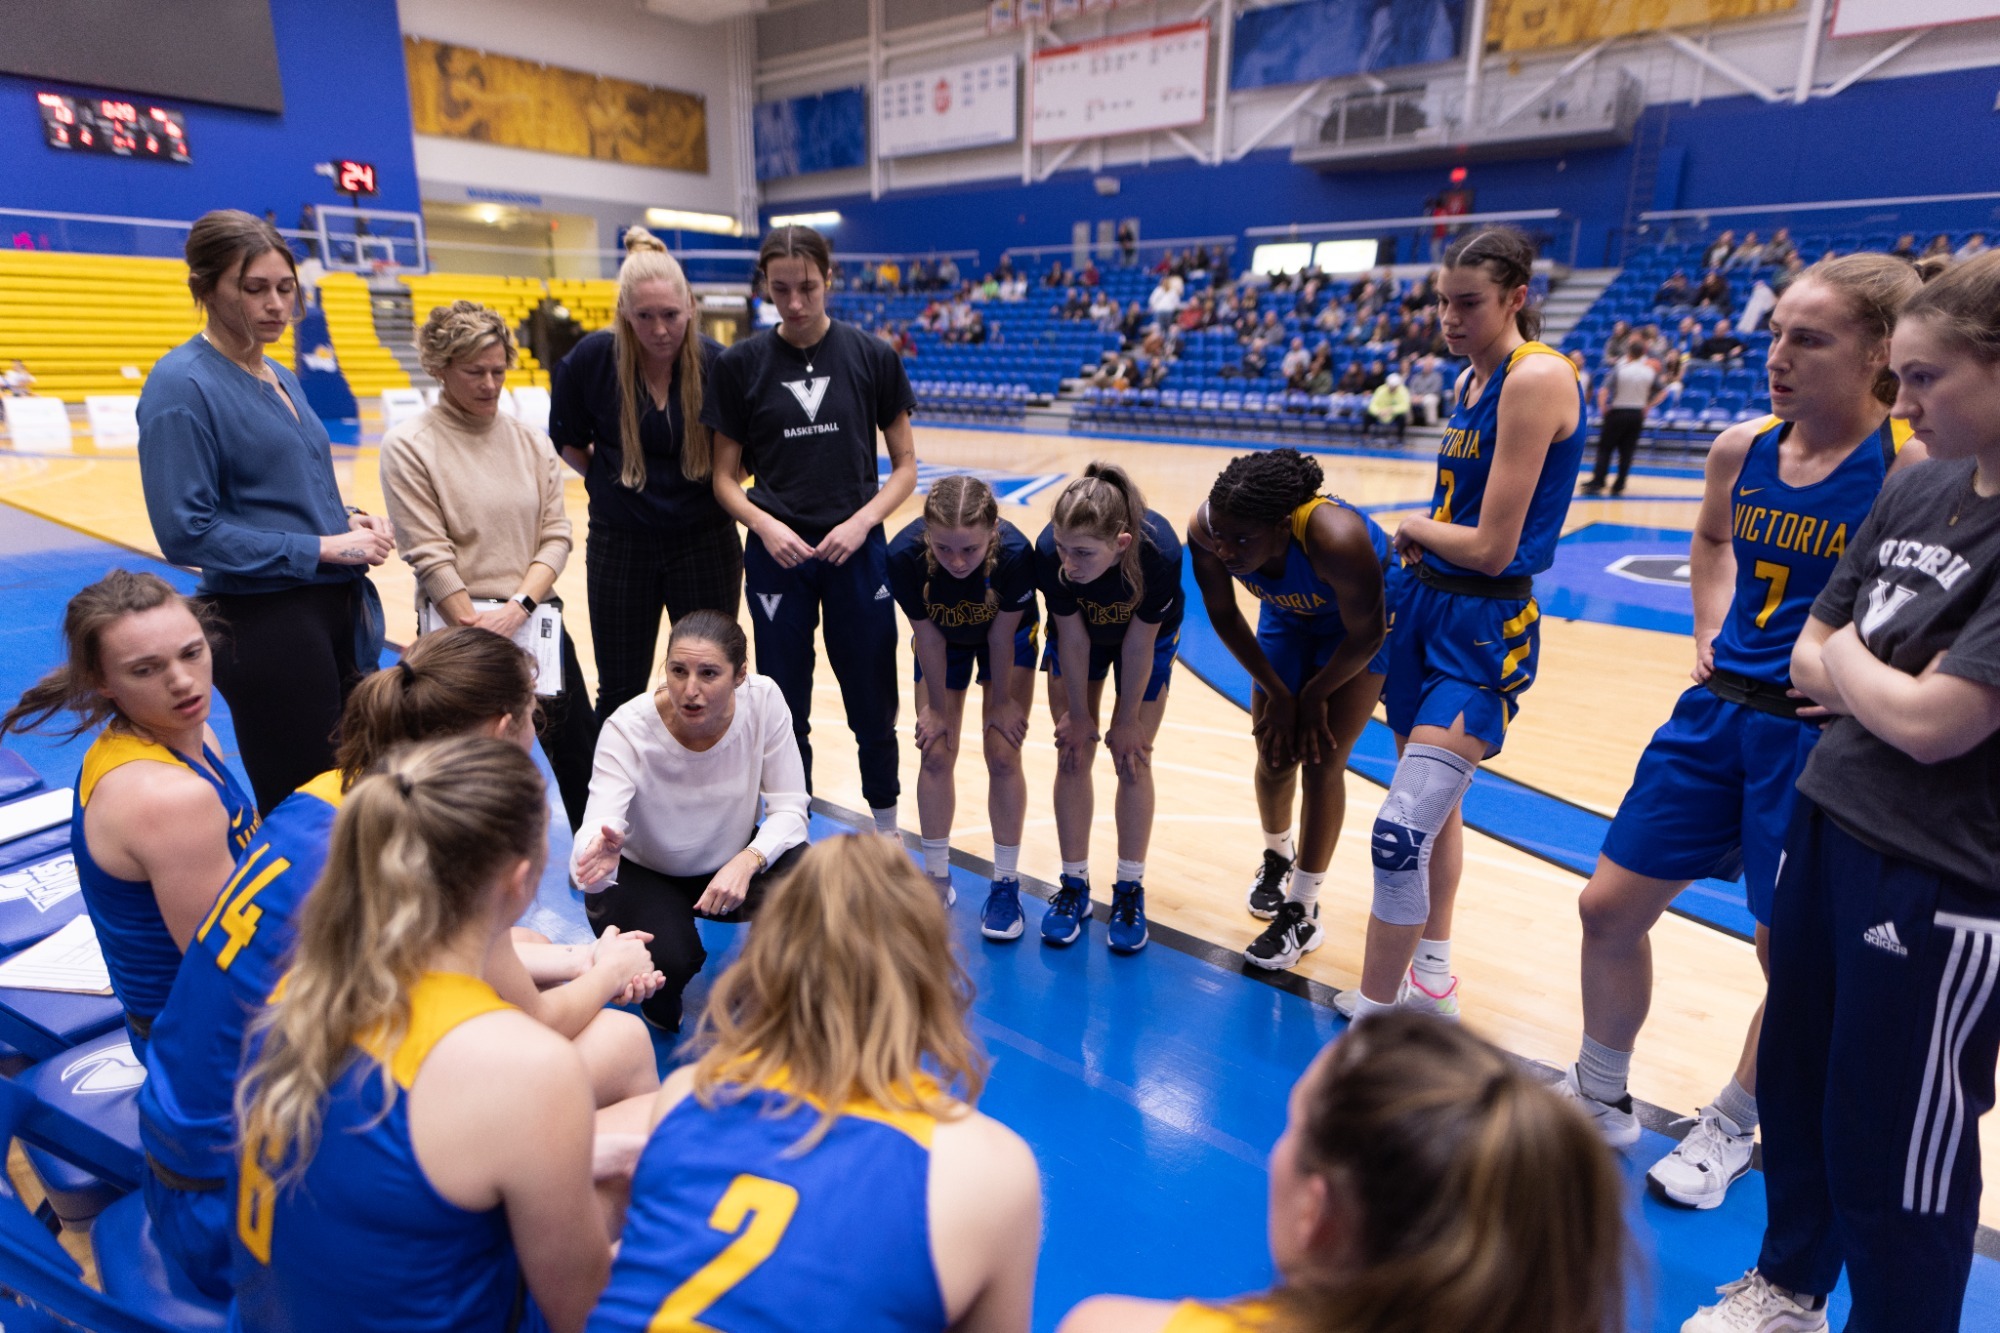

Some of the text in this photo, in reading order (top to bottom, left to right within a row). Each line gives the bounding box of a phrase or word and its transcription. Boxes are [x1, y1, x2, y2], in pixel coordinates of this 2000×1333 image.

[341, 160, 374, 192] 24
[780, 376, 831, 422] V
[784, 422, 840, 438] BASKETBALL
[1733, 503, 1848, 558] VICTORIA
[756, 592, 783, 622] V
[1754, 560, 1790, 629] 7
[197, 842, 292, 972] 14
[1863, 932, 1908, 956] adidas
[644, 1173, 799, 1333] 2
